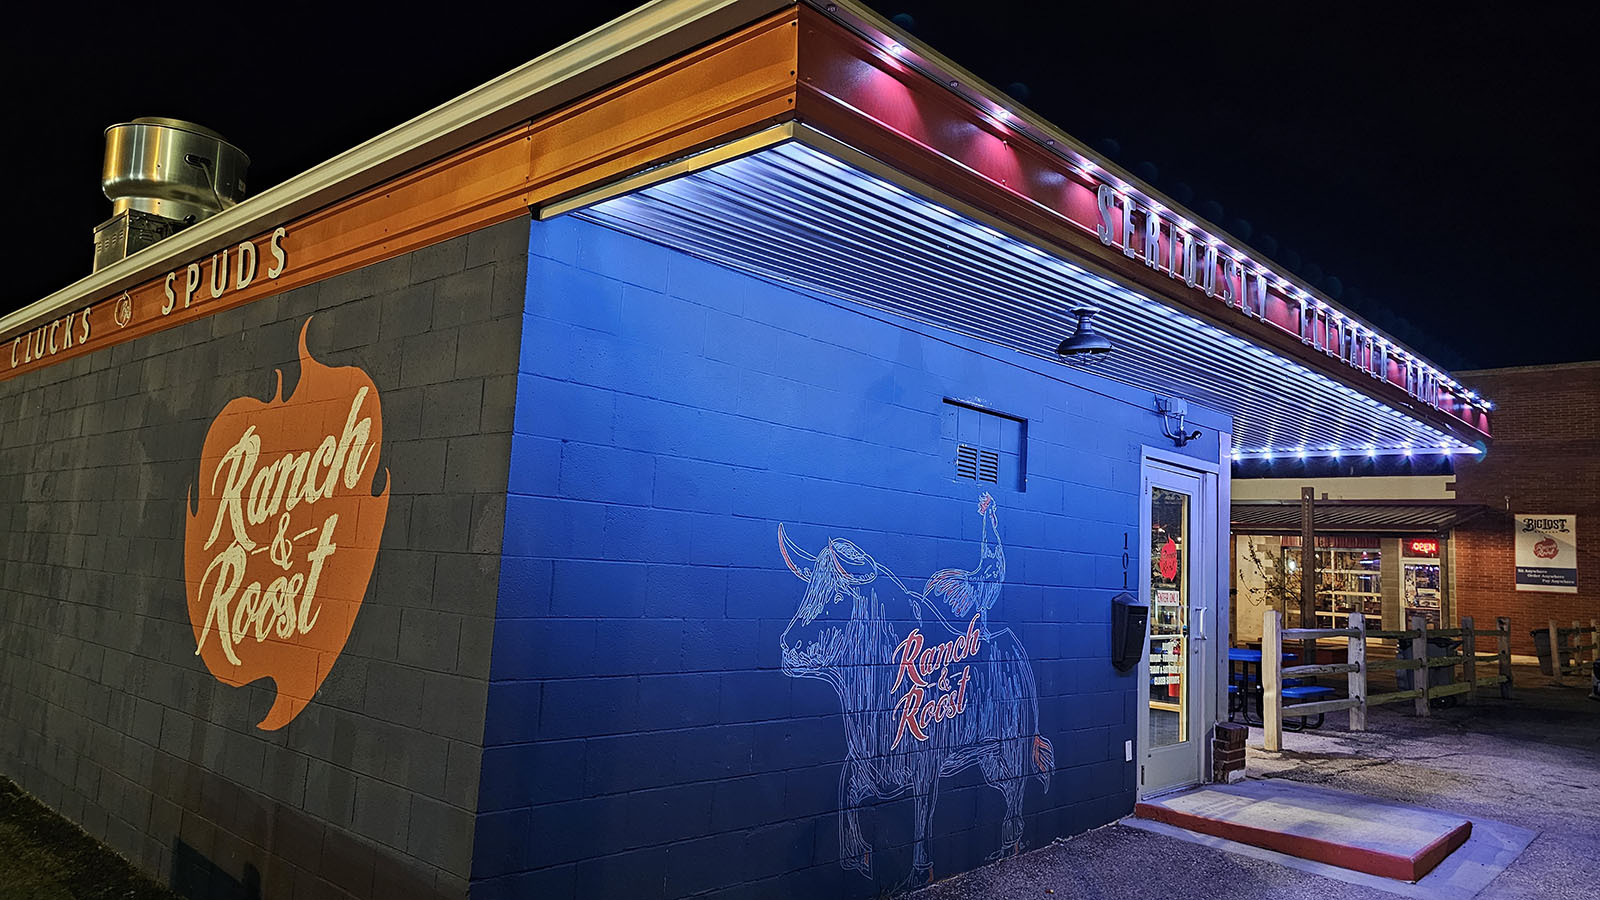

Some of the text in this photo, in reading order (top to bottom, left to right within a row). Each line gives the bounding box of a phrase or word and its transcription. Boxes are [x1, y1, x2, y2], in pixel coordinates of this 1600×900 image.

[10, 226, 287, 368] CLUCKS SPUDS
[1097, 183, 1267, 323] SERIOUSLY
[203, 386, 375, 551] Ranch
[195, 514, 339, 666] Roost
[1412, 542, 1436, 554] OPEN
[890, 613, 981, 695] Ranch
[890, 665, 971, 751] Roost
